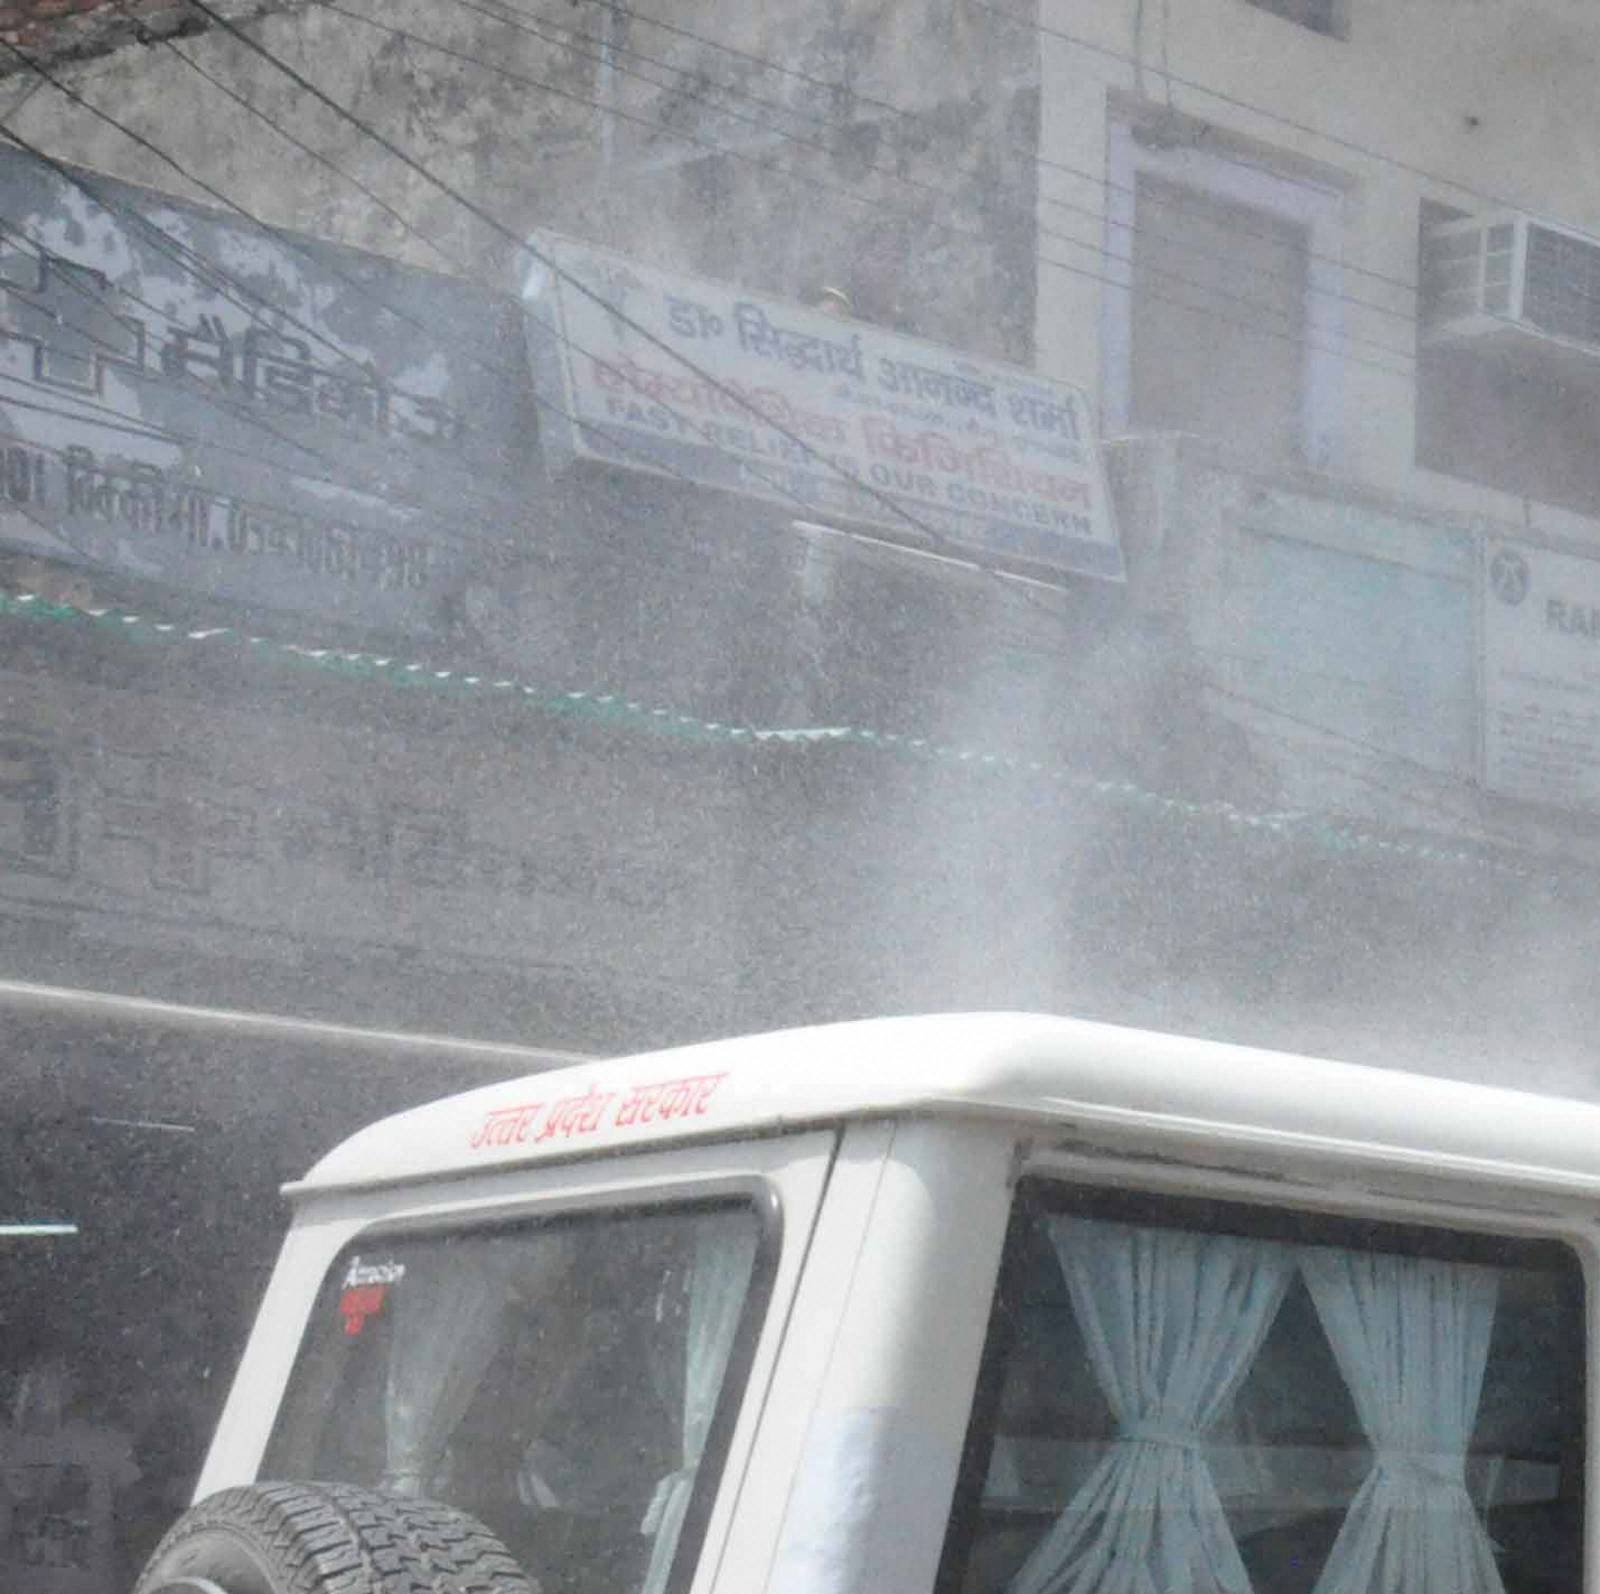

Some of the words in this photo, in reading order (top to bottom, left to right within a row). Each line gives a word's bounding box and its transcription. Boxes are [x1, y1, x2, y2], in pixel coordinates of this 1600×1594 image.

[867, 460, 937, 498] OUR
[470, 1103, 546, 1149] उत्तर
[534, 1081, 617, 1144] प्रदेश
[615, 1071, 730, 1128] सरकार
